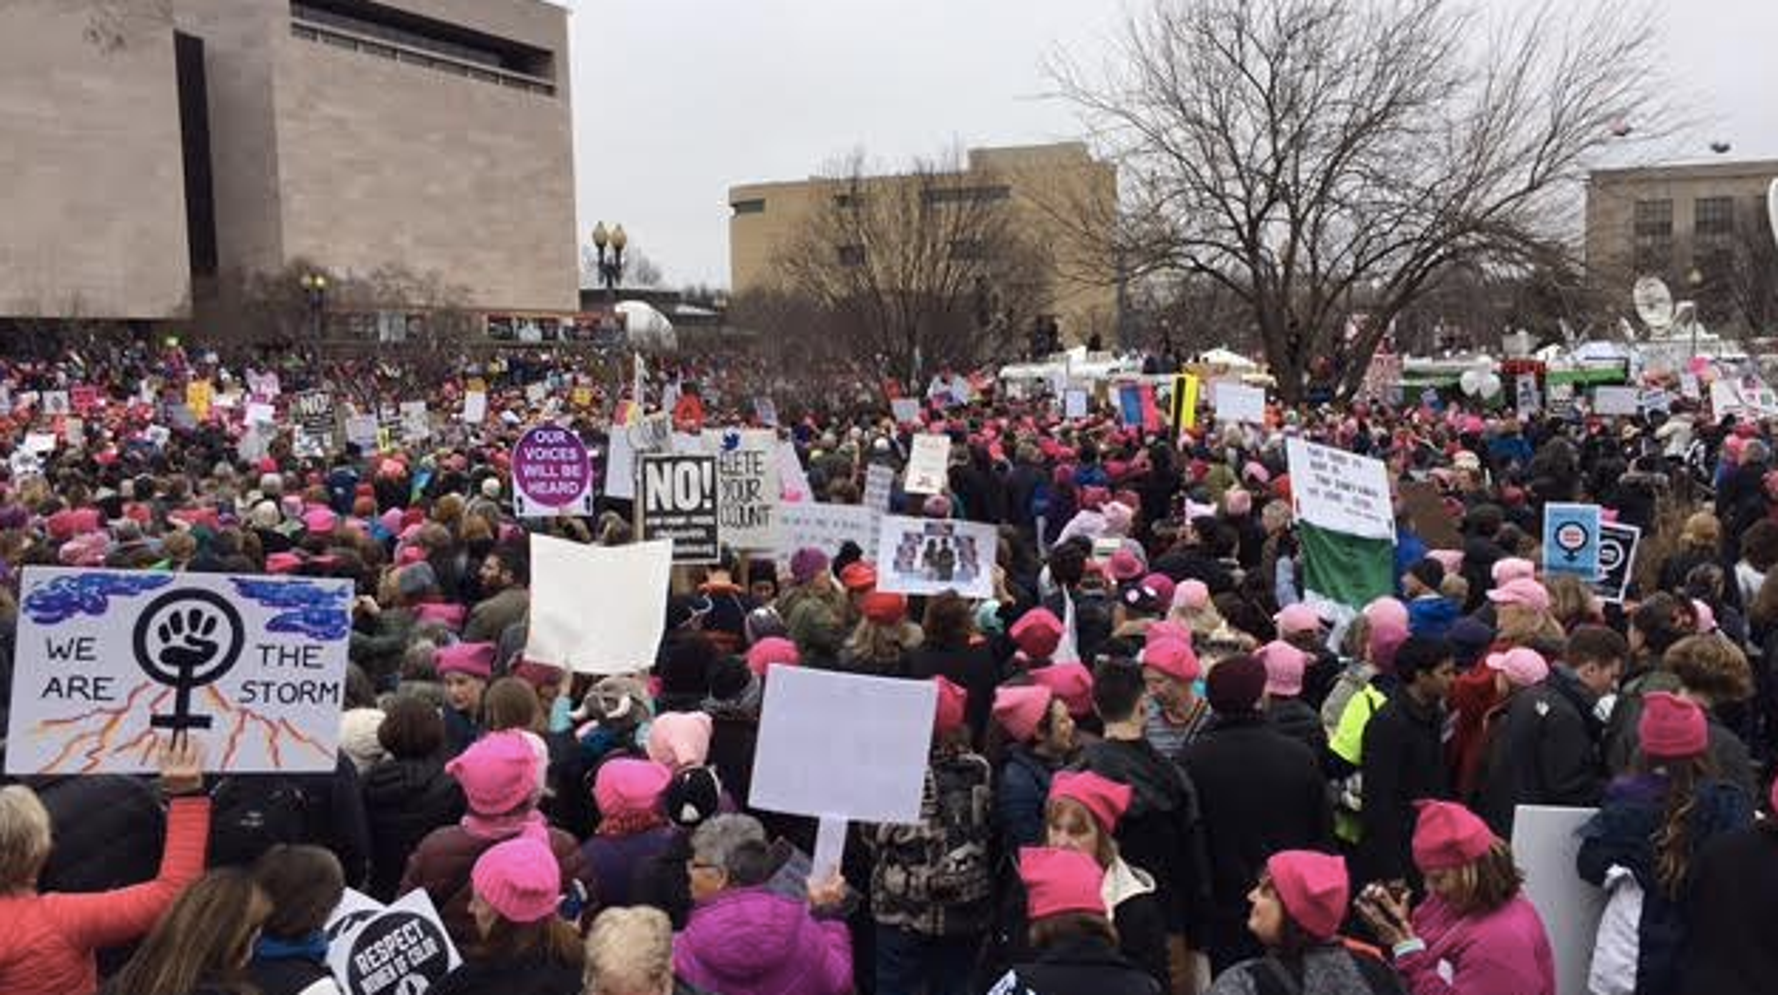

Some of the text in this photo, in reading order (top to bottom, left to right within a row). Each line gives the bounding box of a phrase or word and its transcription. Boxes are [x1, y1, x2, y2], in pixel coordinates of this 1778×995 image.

[535, 430, 567, 443] OUR
[523, 446, 578, 461] VOICES
[720, 451, 766, 476] ELETE
[521, 463, 582, 478] WILL BE
[526, 481, 580, 495] HEARD
[646, 461, 713, 511] NO!
[720, 503, 773, 529] COUNT
[46, 637, 97, 661] WE
[256, 644, 325, 669] THE
[41, 676, 115, 701] ARE
[239, 680, 340, 704] STORM
[354, 919, 424, 976] RESPECT
